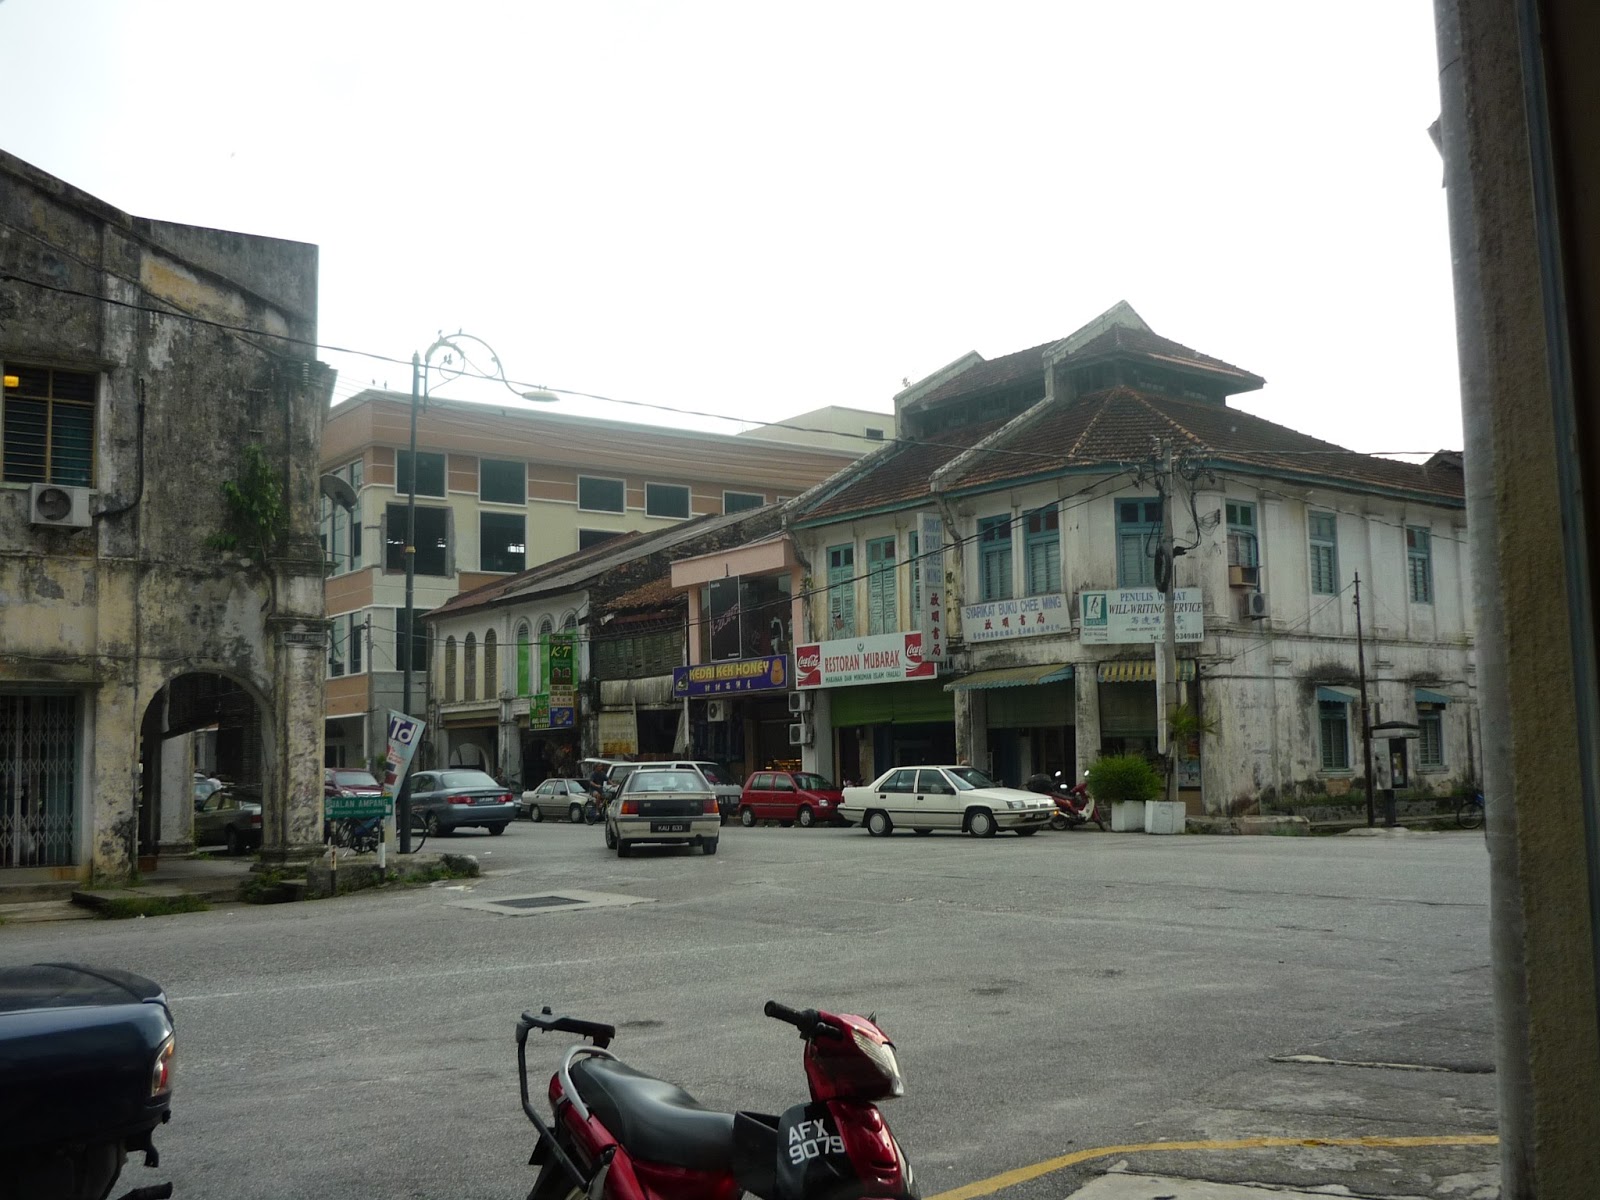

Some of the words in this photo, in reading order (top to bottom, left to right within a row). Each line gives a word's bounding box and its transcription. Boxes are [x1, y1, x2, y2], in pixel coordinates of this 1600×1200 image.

[966, 603, 995, 619] SYARIKAT
[998, 600, 1017, 615] BUKU
[1020, 598, 1039, 613] CHEE
[1041, 596, 1061, 610] MING
[1109, 603, 1165, 614] WILL-WRITING
[1173, 602, 1202, 613] ERVICE
[1120, 592, 1153, 602] PENULIS
[688, 666, 715, 681] KEDAI
[716, 664, 734, 679] KEK
[735, 660, 769, 677] HONEY
[824, 654, 859, 673] RESTORAN
[863, 650, 901, 670] MUBARAK
[331, 799, 355, 808] JALAN
[358, 798, 388, 808] AMPANG
[788, 1118, 829, 1145] AFX
[788, 1135, 846, 1165] 9079
